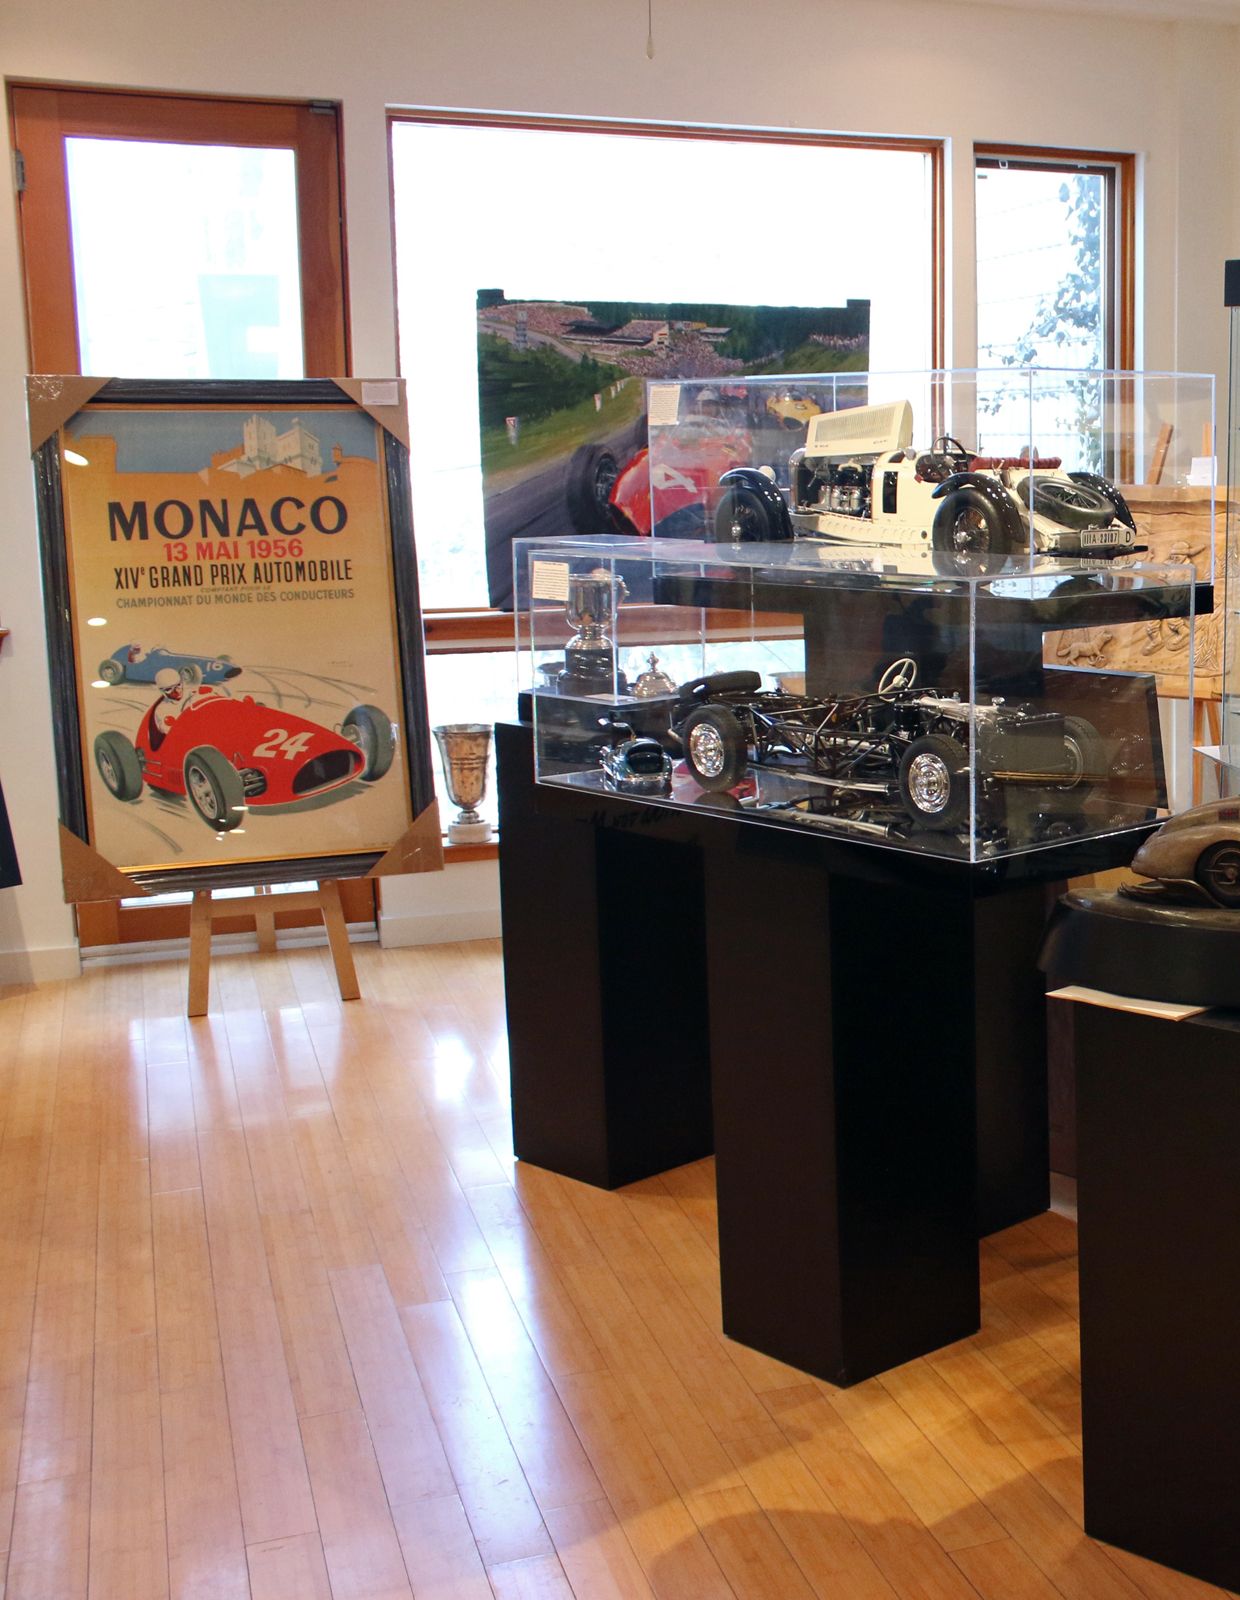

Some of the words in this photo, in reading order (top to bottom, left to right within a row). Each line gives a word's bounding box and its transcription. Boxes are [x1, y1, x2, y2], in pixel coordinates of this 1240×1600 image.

[107, 495, 348, 542] MONACO
[1125, 531, 1132, 543] D
[163, 542, 189, 563] 13
[195, 540, 240, 561] MAI
[246, 538, 304, 560] 1956
[149, 565, 204, 588] GRAND
[210, 562, 247, 586] PRIX
[253, 559, 353, 584] AUTOMOBILE
[115, 594, 193, 610] CHAMPIONNAT
[198, 593, 212, 606] DU
[214, 590, 254, 605] MONDE
[256, 590, 277, 603] DES
[281, 588, 355, 602] CONDUCTEURS
[205, 661, 223, 672] 16
[252, 728, 315, 760] 24
